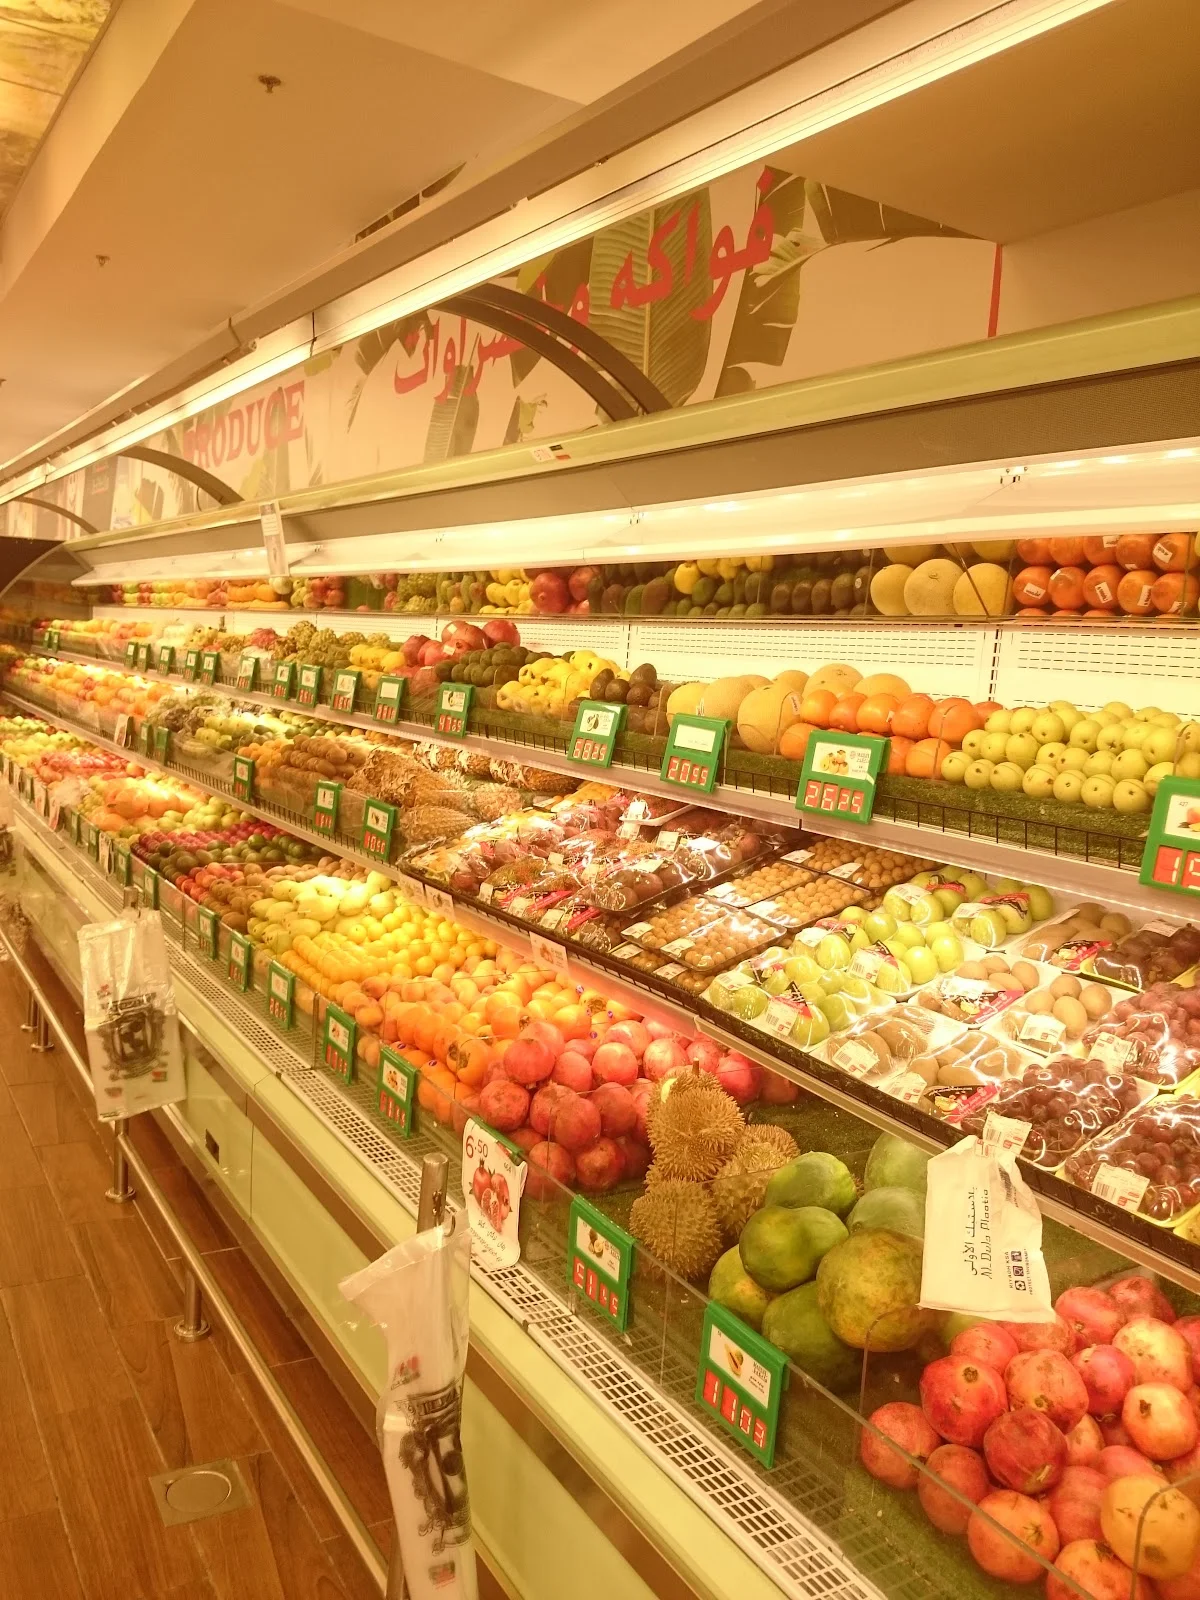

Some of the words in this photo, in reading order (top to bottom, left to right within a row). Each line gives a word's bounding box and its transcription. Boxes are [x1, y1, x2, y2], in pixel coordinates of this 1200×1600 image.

[610, 166, 776, 321] فواكه
[183, 380, 304, 469] PRODUCE
[465, 1135, 489, 1158] 6.50
